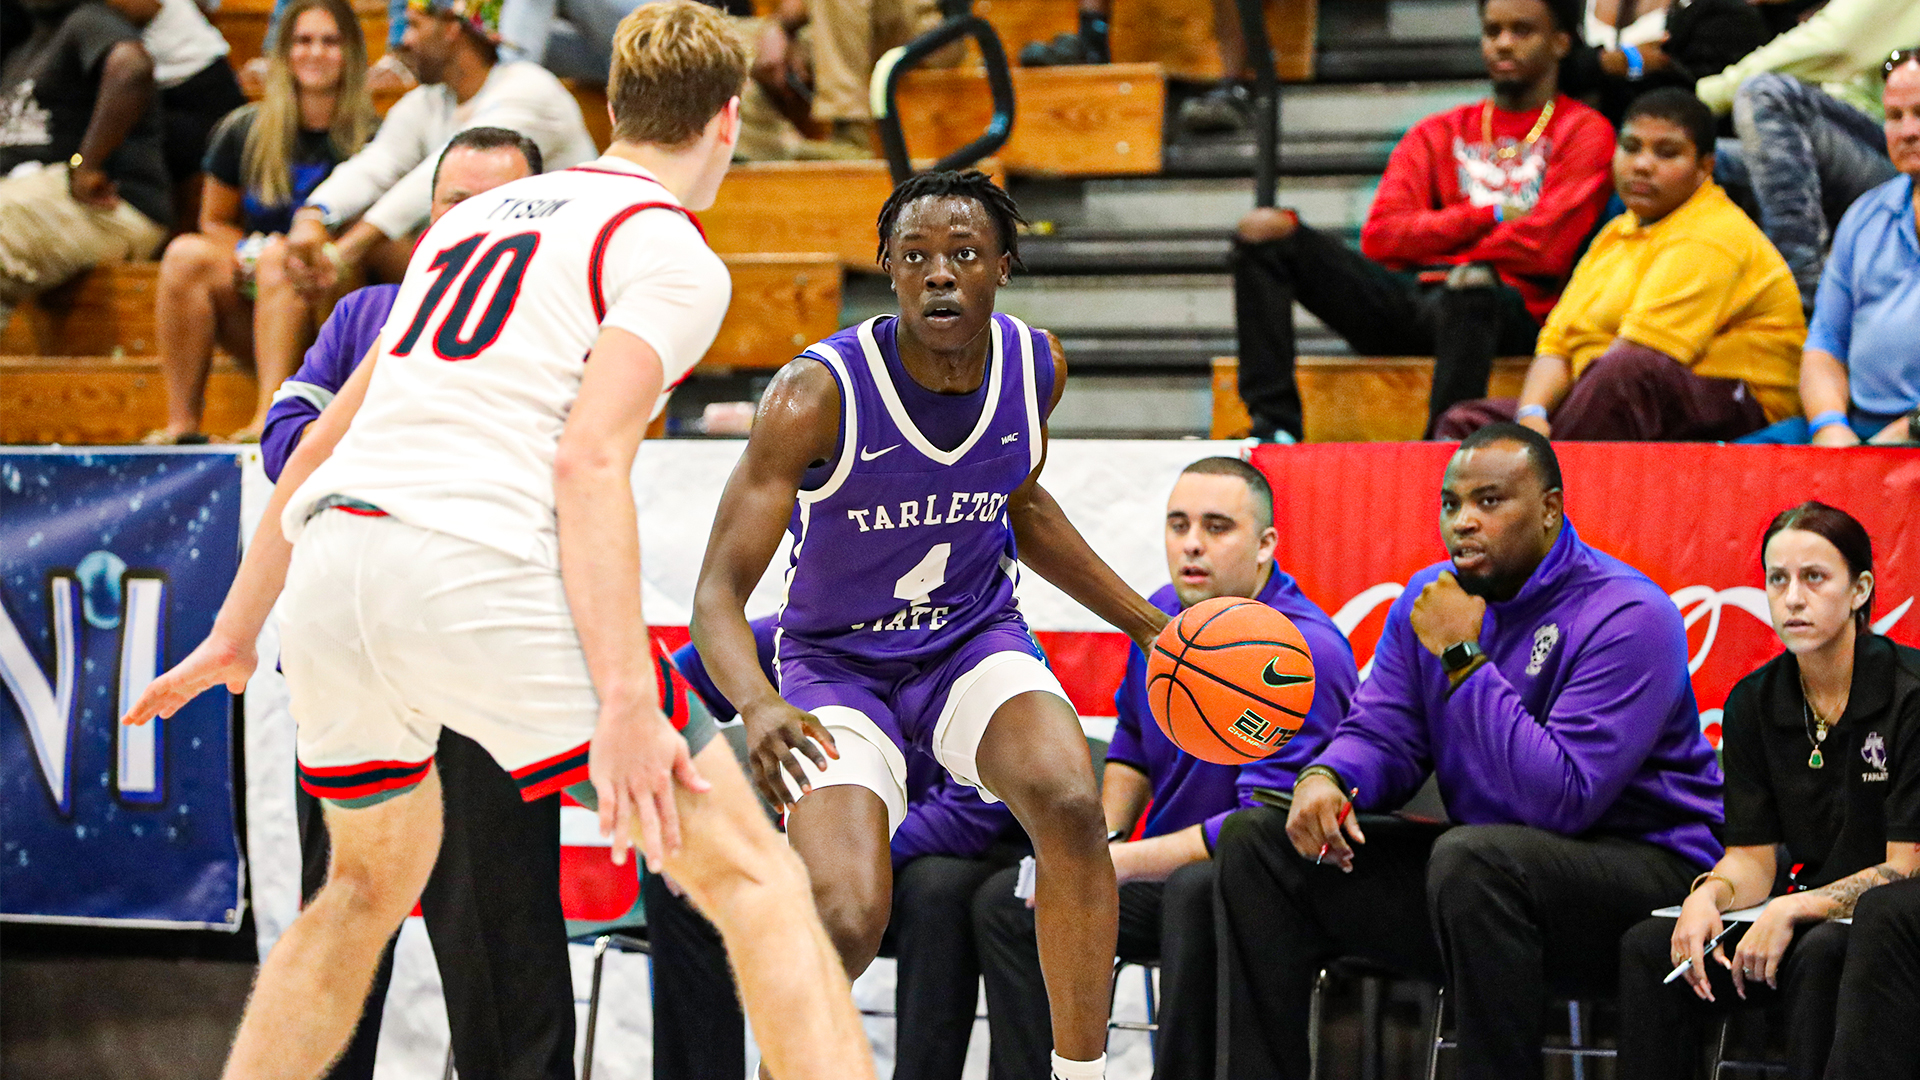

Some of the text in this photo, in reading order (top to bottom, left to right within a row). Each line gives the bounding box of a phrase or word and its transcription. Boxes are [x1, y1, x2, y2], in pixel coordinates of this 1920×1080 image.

[486, 198, 575, 220] TYSON
[388, 231, 541, 361] 10
[1001, 432, 1019, 445] WAC
[893, 542, 951, 607] 4
[851, 606, 949, 632] ATE
[1233, 708, 1299, 747] ELITE
